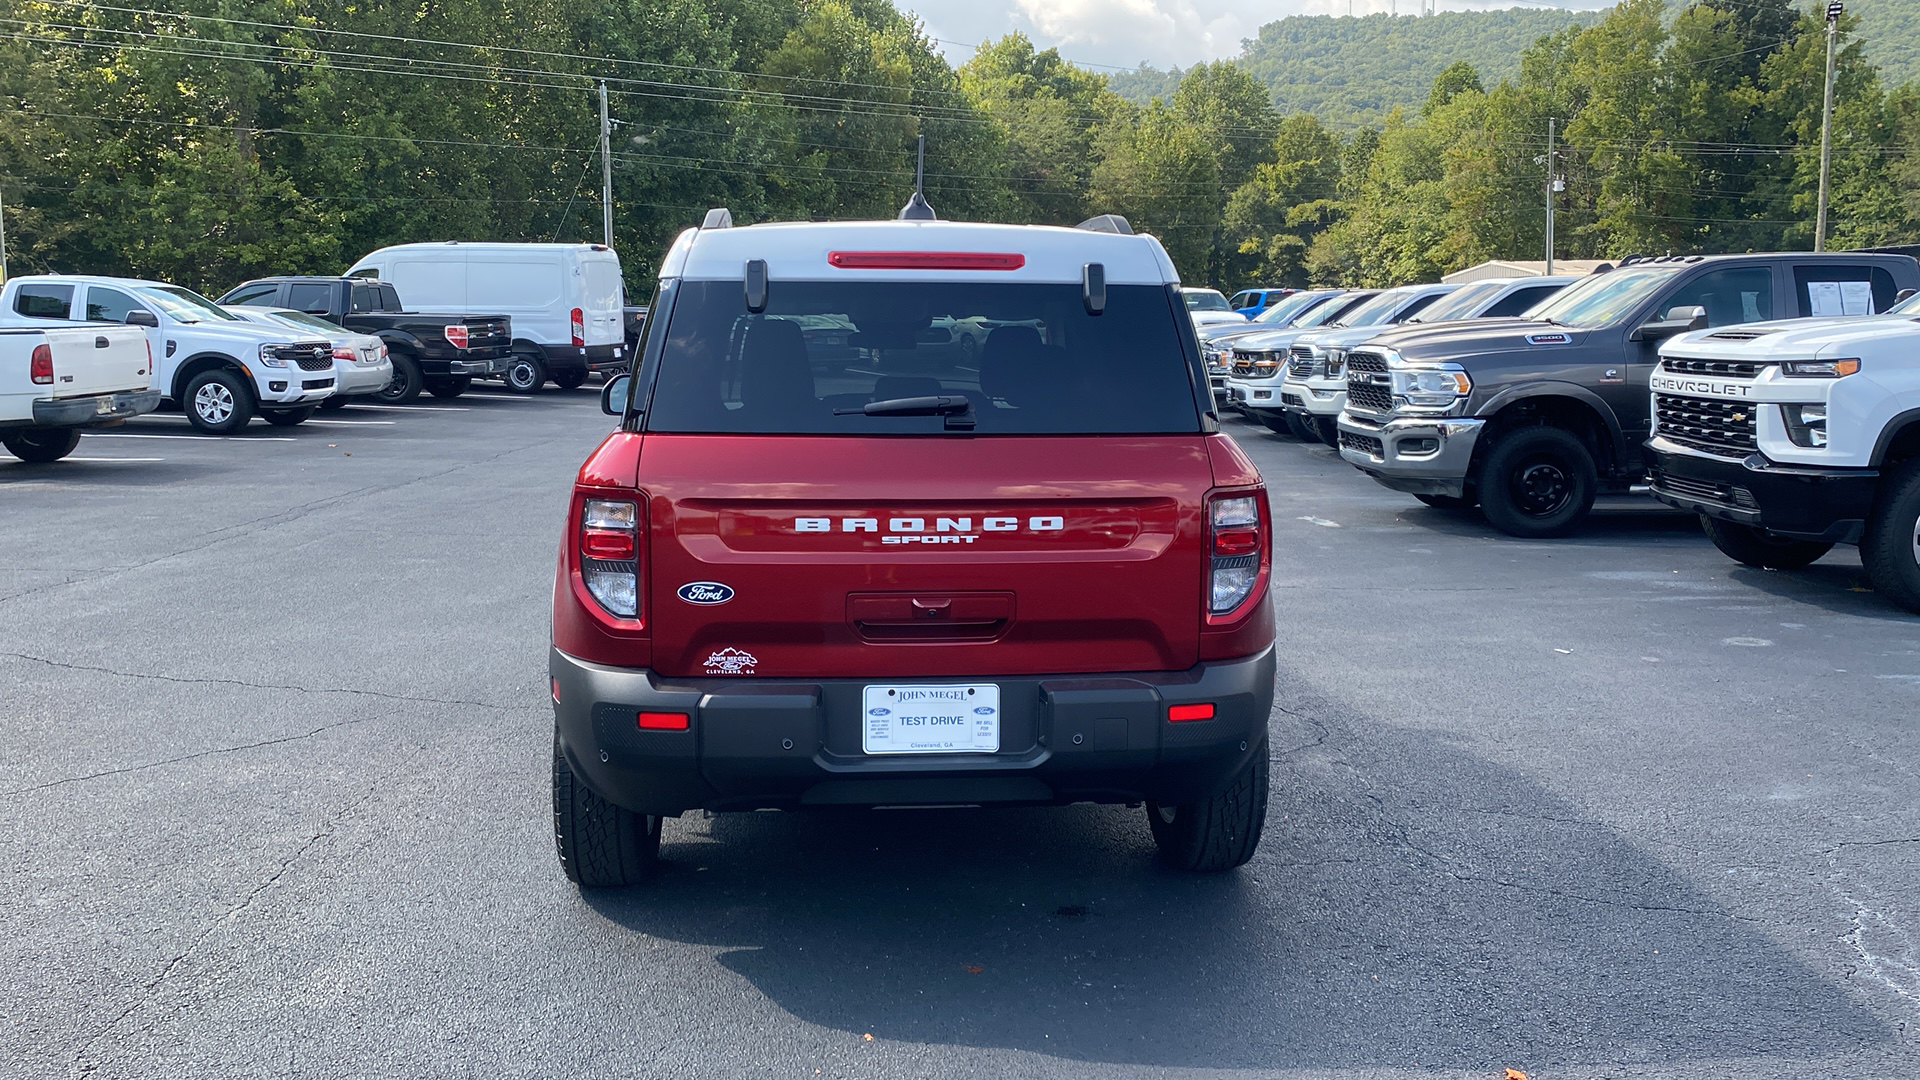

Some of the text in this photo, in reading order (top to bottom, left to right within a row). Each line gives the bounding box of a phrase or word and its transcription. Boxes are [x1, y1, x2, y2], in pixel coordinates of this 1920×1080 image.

[1652, 378, 1752, 396] CHEVROLET
[795, 517, 1064, 532] BRONCO
[881, 535, 979, 544] SPORT
[688, 585, 724, 600] Ford
[898, 690, 967, 703] JOHN MEGEL
[899, 716, 928, 726] TEST
[930, 716, 964, 725] DRIVE
